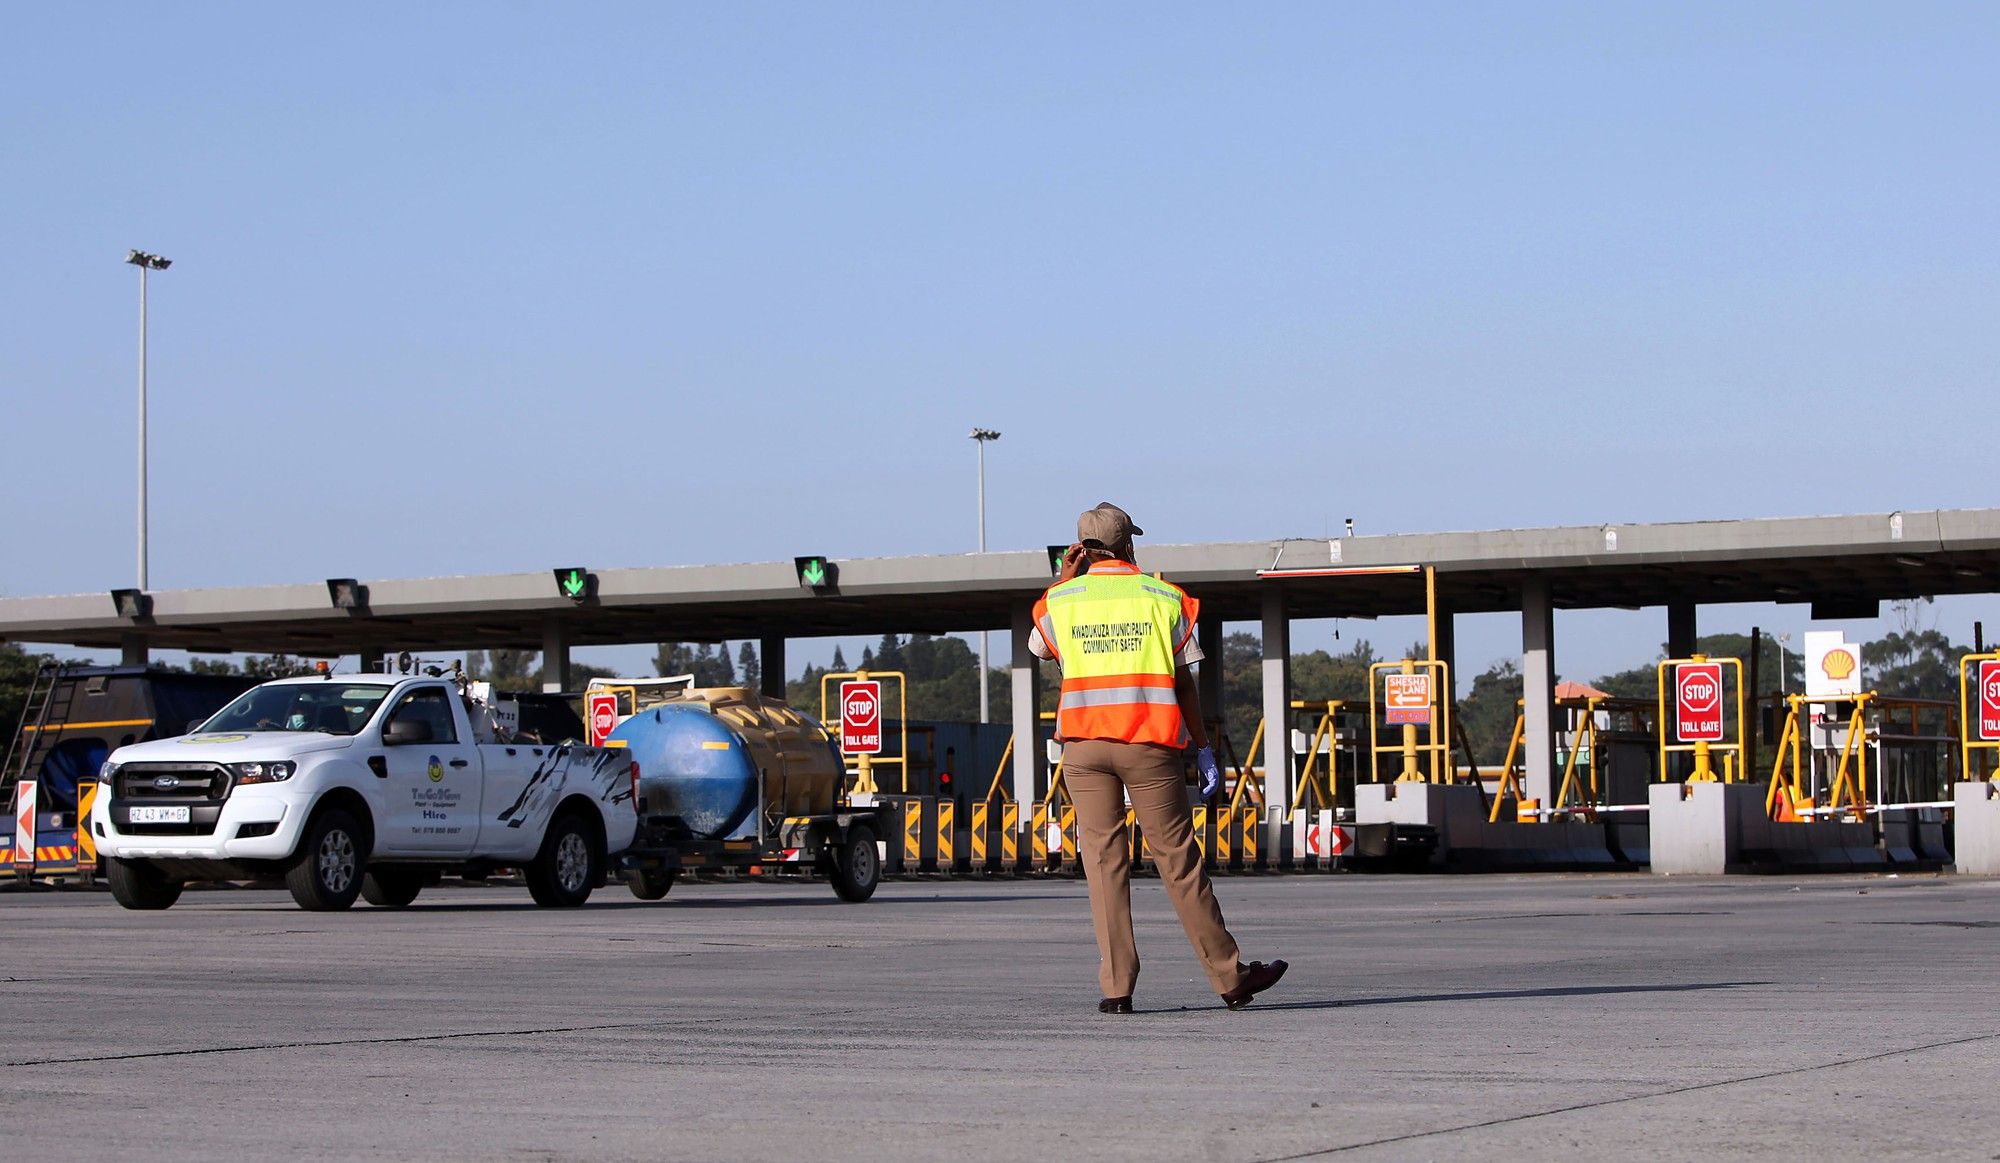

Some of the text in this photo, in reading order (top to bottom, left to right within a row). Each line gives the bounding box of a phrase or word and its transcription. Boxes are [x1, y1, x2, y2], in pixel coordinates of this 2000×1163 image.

[1072, 622, 1153, 639] KWADUKUZA MUNICIPALITY
[1082, 638, 1143, 654] COMMUNITY SAFETY
[1390, 677, 1426, 687] SHESHA
[1402, 686, 1426, 695] LANE
[1685, 684, 1713, 700] STOP
[1989, 682, 2000, 698] ST
[848, 701, 873, 715] STOP
[596, 714, 612, 728] STOP
[1681, 721, 1719, 733] TOLL GATE
[845, 735, 878, 746] TOLL GATE
[145, 809, 155, 820] 43
[177, 809, 187, 820] GP
[423, 810, 447, 820] Hire
